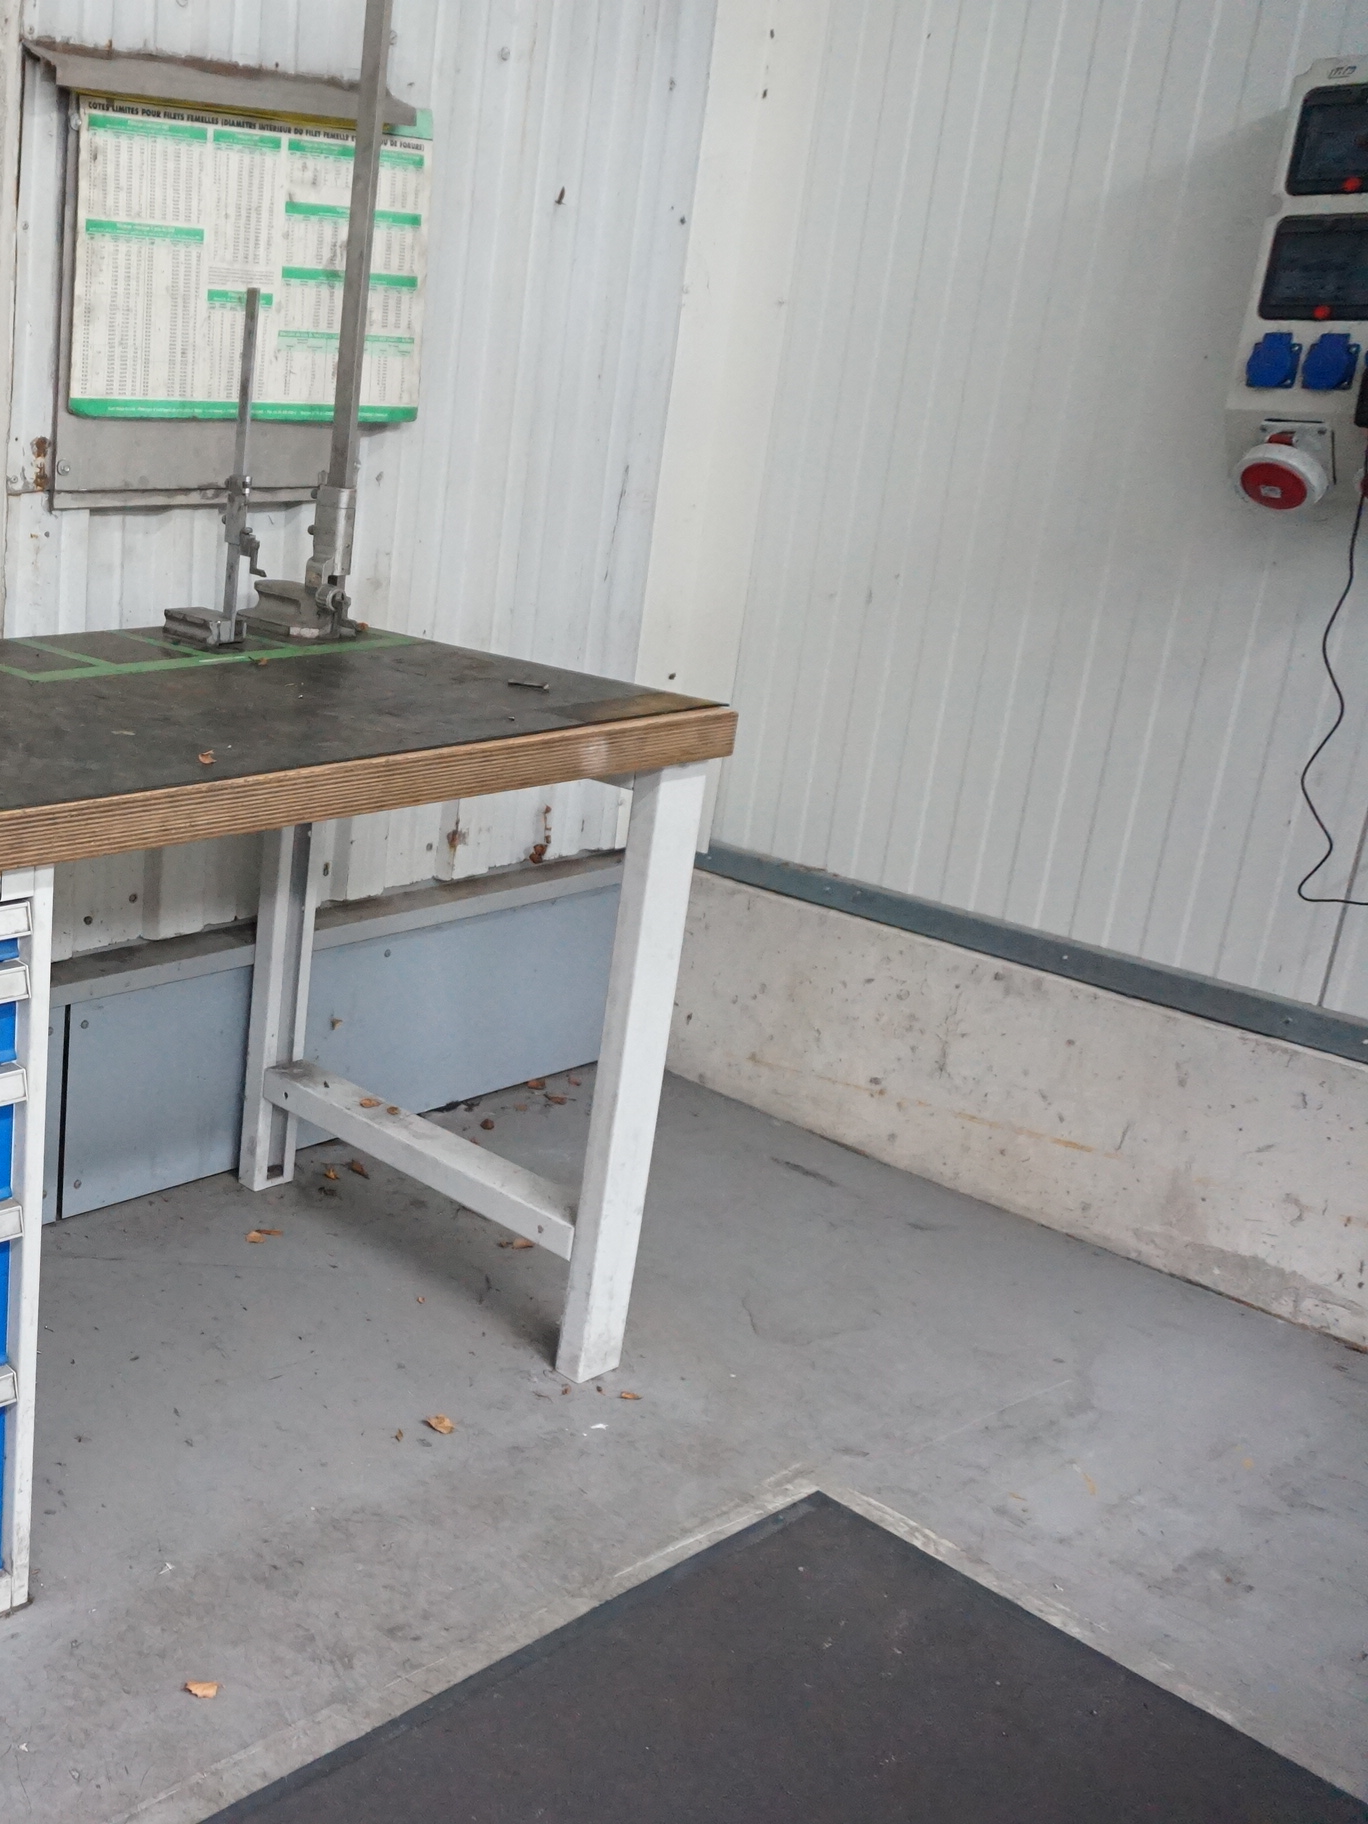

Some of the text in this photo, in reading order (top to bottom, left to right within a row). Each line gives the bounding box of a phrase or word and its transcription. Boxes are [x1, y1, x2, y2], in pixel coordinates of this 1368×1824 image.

[88, 101, 110, 111] COTES
[111, 104, 139, 115] LIMITES
[141, 108, 162, 118] POUR
[163, 111, 185, 121] FILETS
[186, 113, 219, 125] FEMELLES
